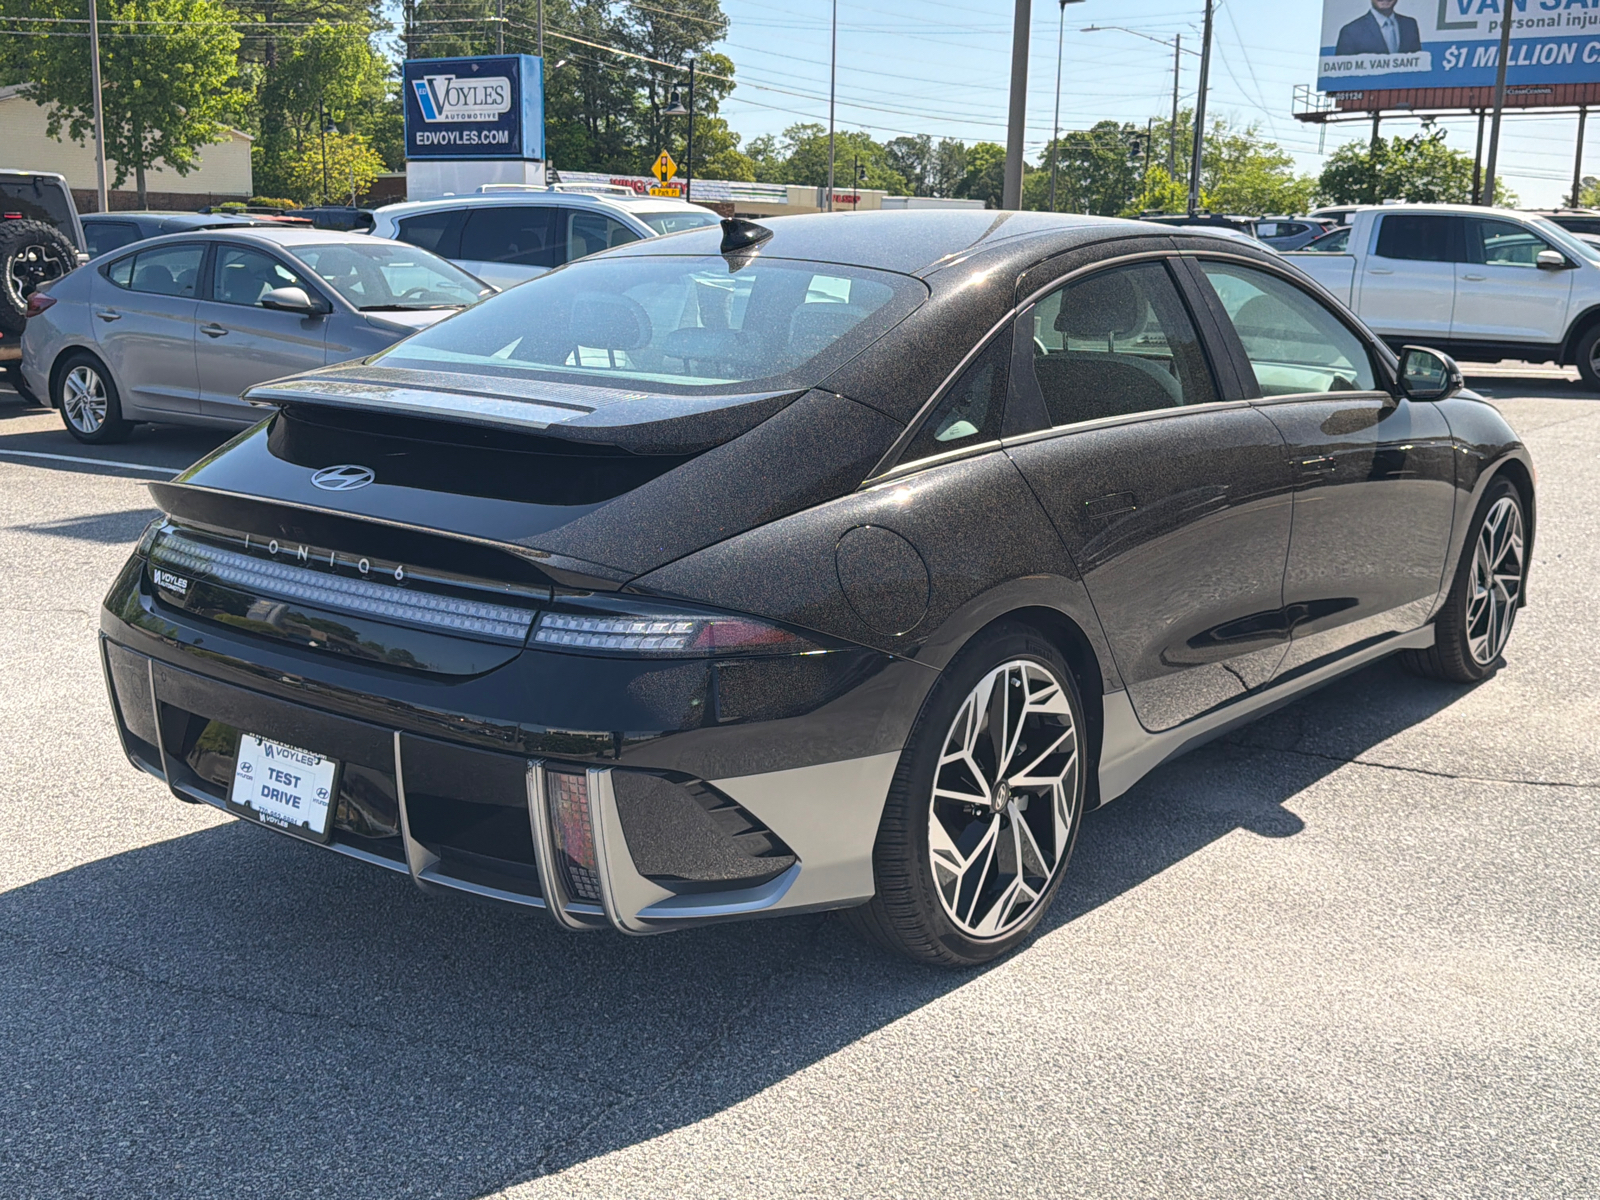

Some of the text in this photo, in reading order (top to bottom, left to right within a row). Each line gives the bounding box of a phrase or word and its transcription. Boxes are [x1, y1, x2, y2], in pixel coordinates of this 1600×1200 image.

[1488, 11, 1600, 33] prsonal inju
[1323, 57, 1420, 72] DAVID M. VAN SANT
[1442, 45, 1468, 71] $1
[1582, 41, 1600, 65] C
[426, 77, 505, 116] VOYLES
[444, 112, 498, 120] AUTOMOTIVE
[416, 130, 508, 145] EDVOYLES.COM
[244, 534, 404, 581] IONIQ 6
[162, 572, 187, 588] VOYLES
[275, 746, 314, 767] VOYLES
[268, 767, 302, 789] TEST
[261, 785, 302, 809] DRIVE
